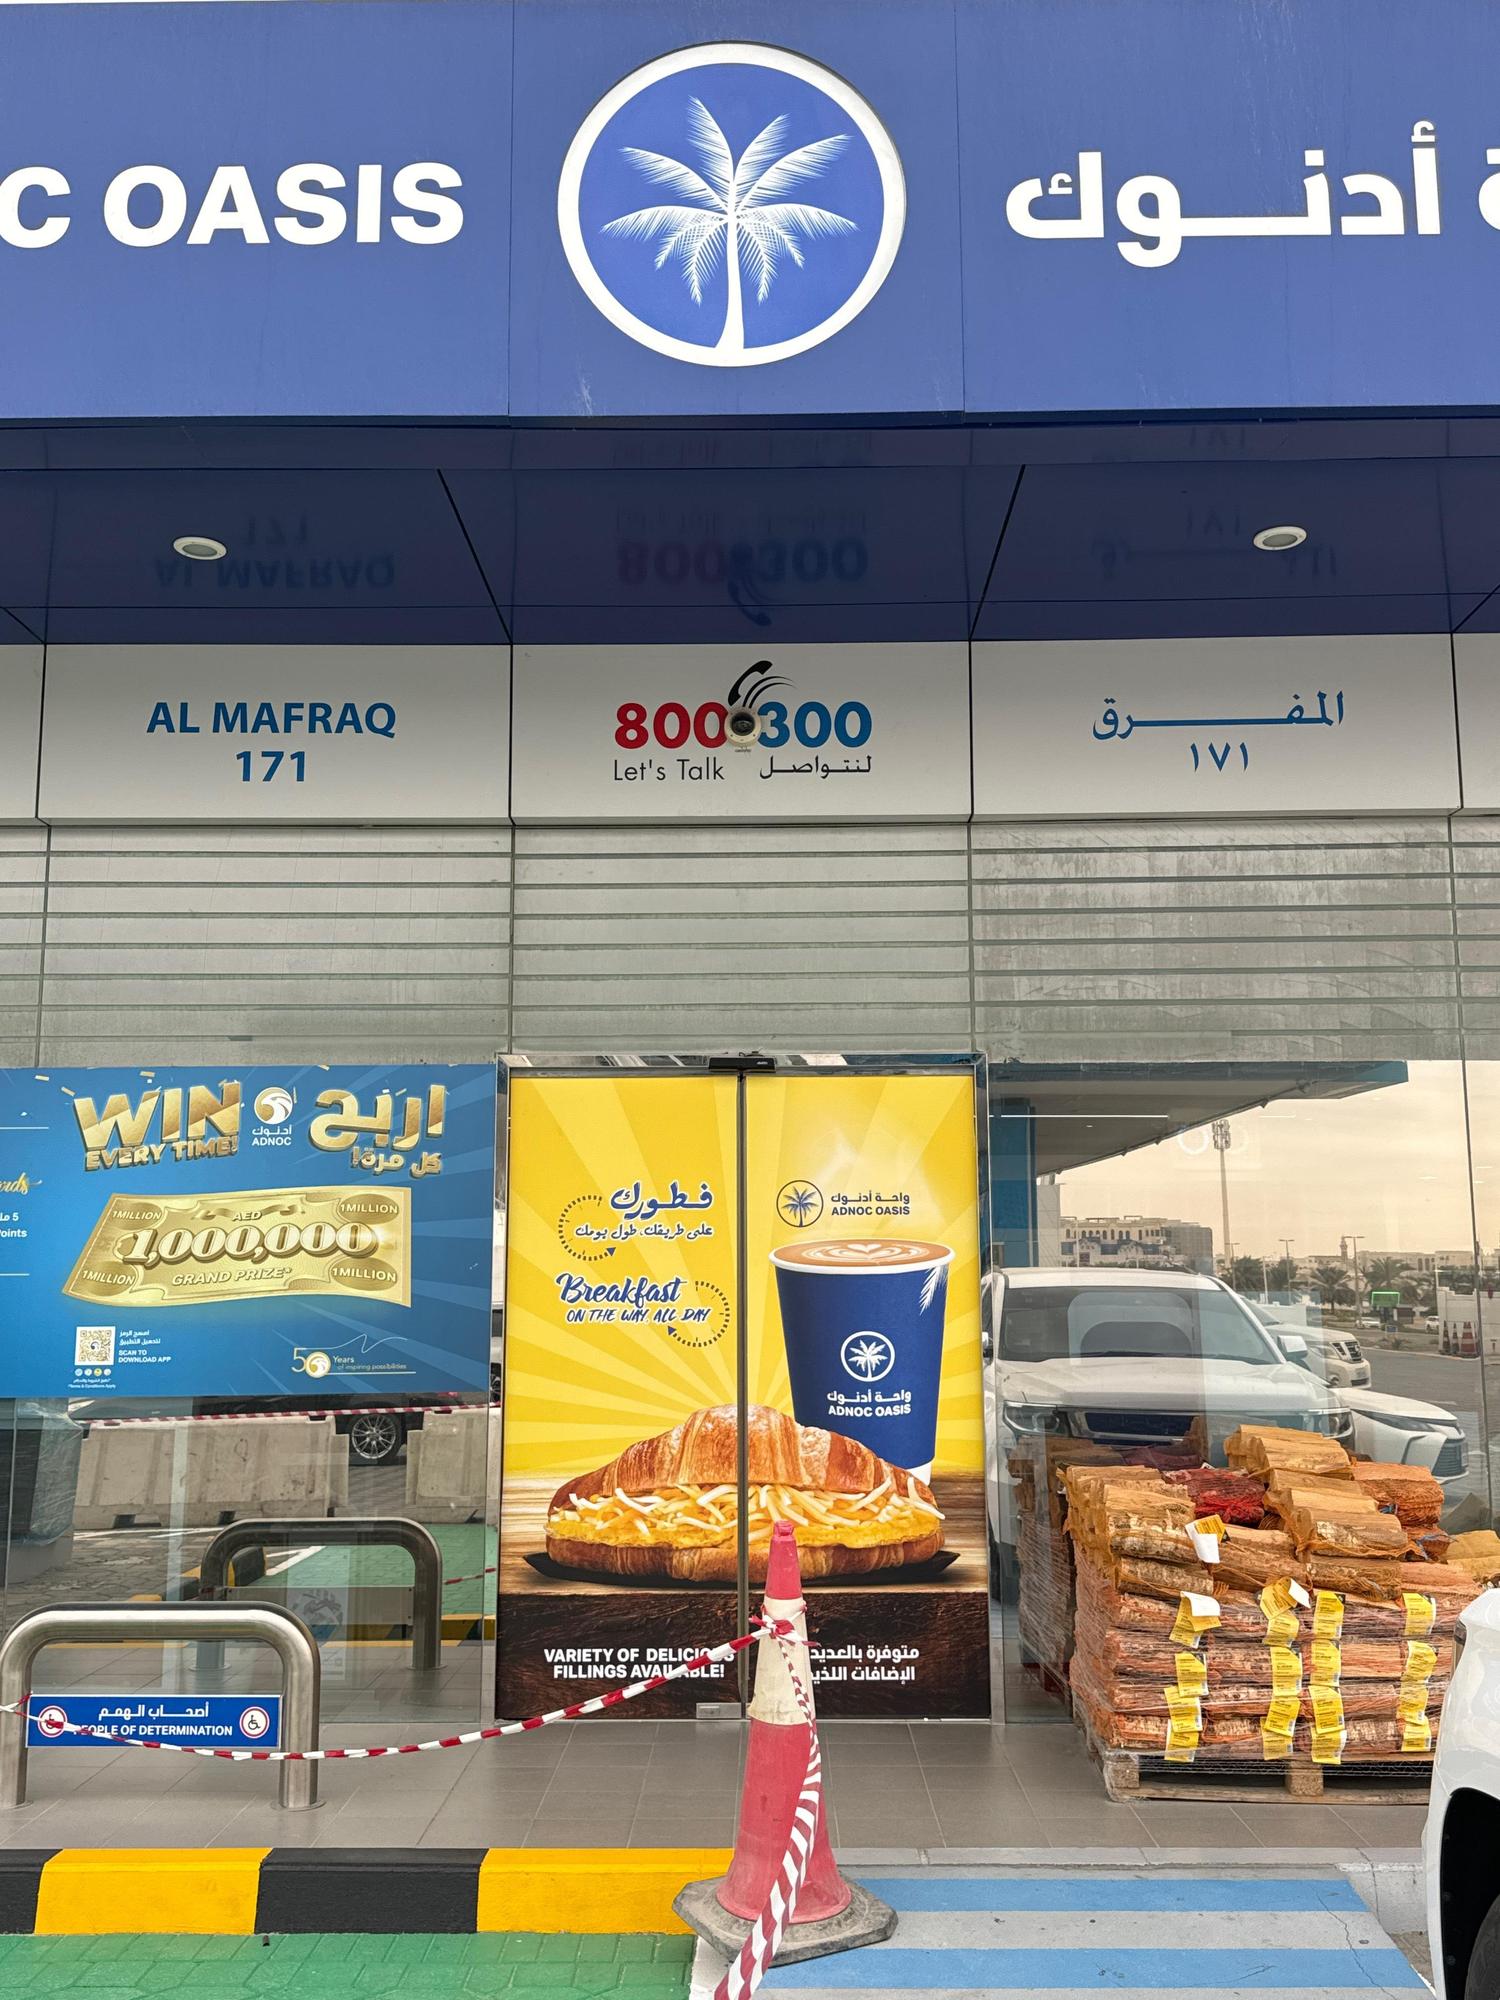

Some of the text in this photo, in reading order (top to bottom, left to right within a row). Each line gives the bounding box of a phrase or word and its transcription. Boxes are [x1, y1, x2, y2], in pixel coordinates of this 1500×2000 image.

[1005, 120, 1441, 268] أدنوك
[103, 161, 465, 248] OASIS
[146, 702, 396, 739] AL MAFRAQ
[614, 701, 872, 749] 800 300
[1092, 690, 1344, 740] المفرق
[236, 751, 306, 782] 171
[1190, 742, 1249, 772] ١٧١
[614, 758, 725, 781] Let's Talk
[759, 755, 872, 780] لنتواصل
[74, 1081, 241, 1150] WIN
[309, 1084, 446, 1151] اربح
[252, 1137, 292, 1146] ADNOC
[85, 1135, 239, 1171] EVERY TIME!
[410, 1152, 442, 1177] كل
[610, 1181, 713, 1220] فطورك
[831, 1190, 910, 1205] واحة أدنوك
[232, 1211, 262, 1221] AED
[831, 1206, 911, 1216] ADNOC OASIS
[575, 1224, 608, 1240] يومك
[610, 1224, 636, 1240] طول
[686, 1224, 713, 1240] على
[122, 1222, 379, 1270] 1,000,000
[172, 1271, 231, 1286] GRAND
[555, 1272, 688, 1308] Breakfast
[566, 1309, 586, 1322] ON
[588, 1308, 618, 1322] THE
[653, 1308, 678, 1322] ALL
[681, 1308, 711, 1322] DAY
[333, 1355, 354, 1363] Years
[827, 1388, 912, 1405] واحة أدنوك
[828, 1403, 912, 1417] ADNOC OASIS
[543, 1648, 614, 1663] VARIETY
[617, 1648, 640, 1662] OF
[866, 1644, 920, 1664] متوفرة
[553, 1664, 627, 1679] FILLINGS
[98, 1701, 209, 1721] أصحاب الهمم
[120, 1725, 136, 1736] OF
[139, 1725, 233, 1736] DETERMINATION
